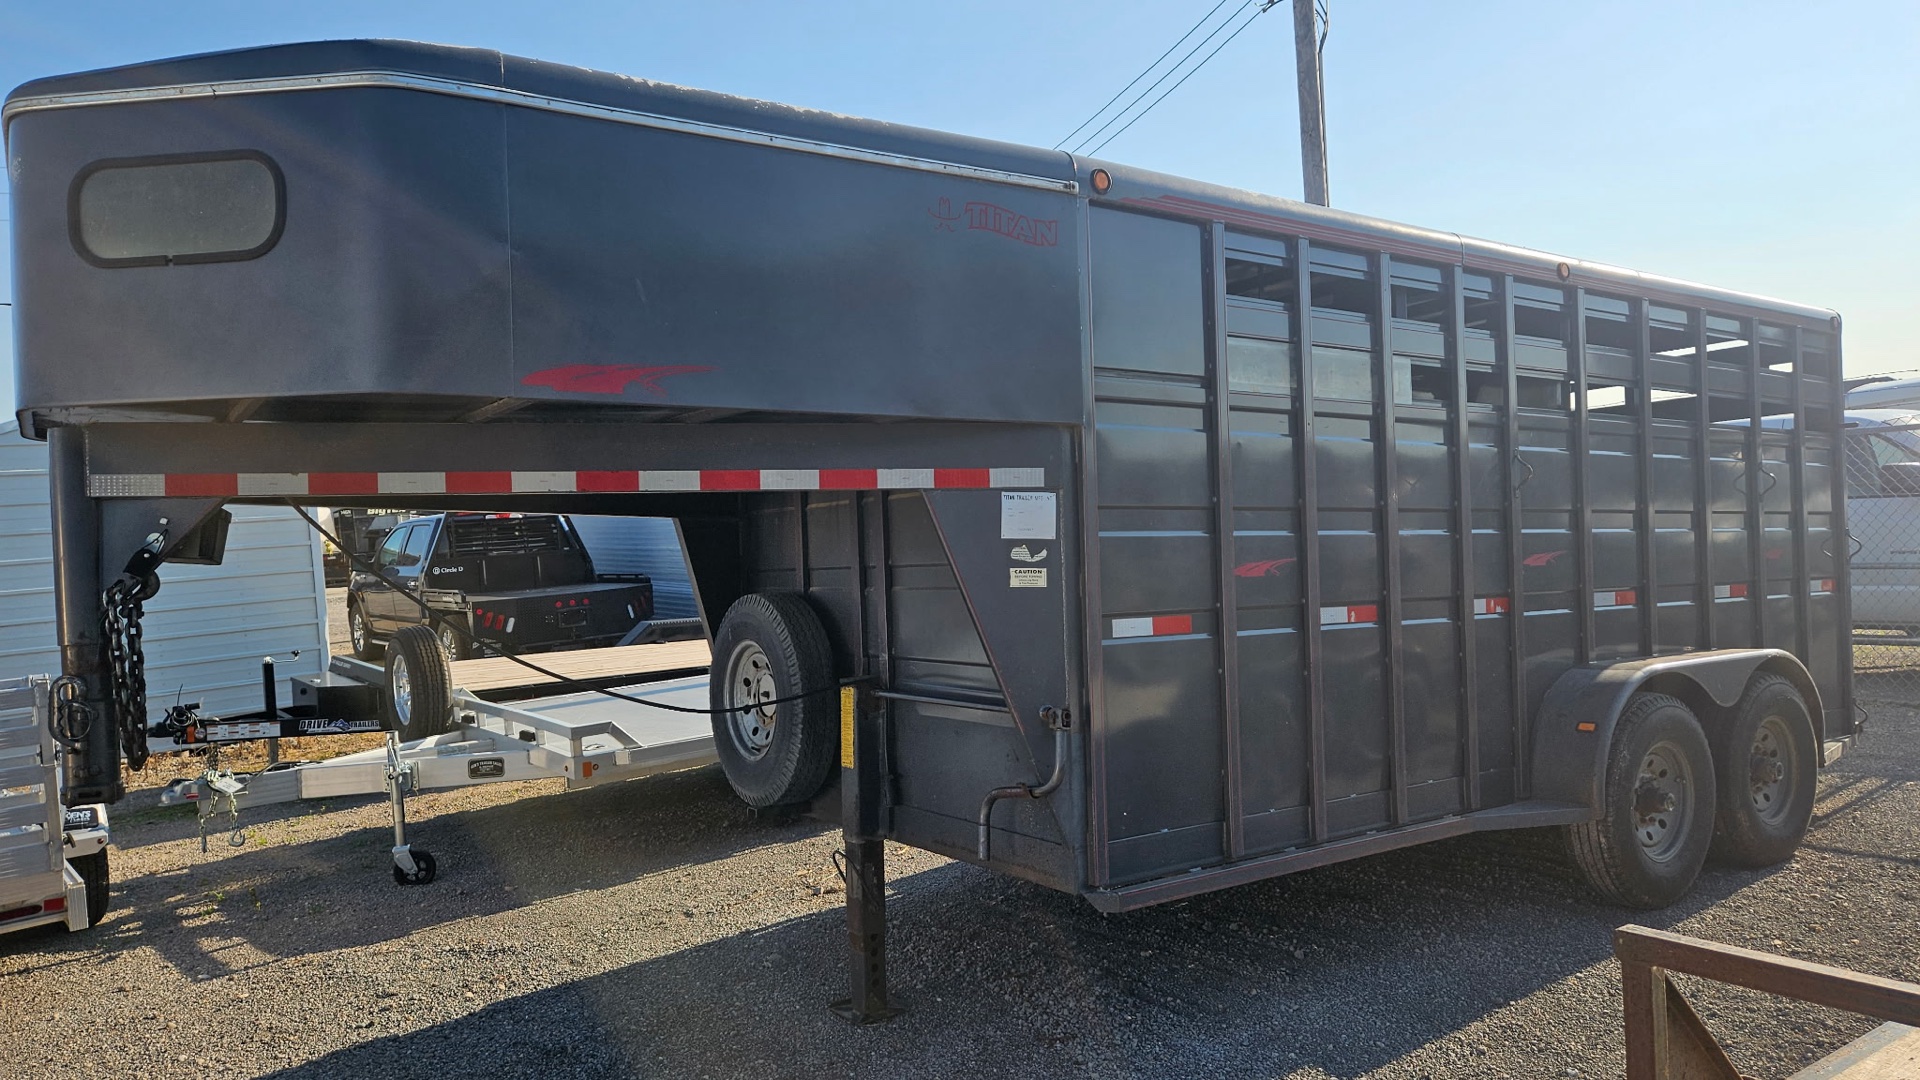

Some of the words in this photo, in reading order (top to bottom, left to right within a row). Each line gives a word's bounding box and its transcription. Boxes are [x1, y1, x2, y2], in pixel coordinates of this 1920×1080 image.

[963, 201, 1058, 247] TITAN
[440, 566, 458, 574] Circle
[299, 719, 329, 731] DRIVE
[350, 720, 380, 728] TRAILERS
